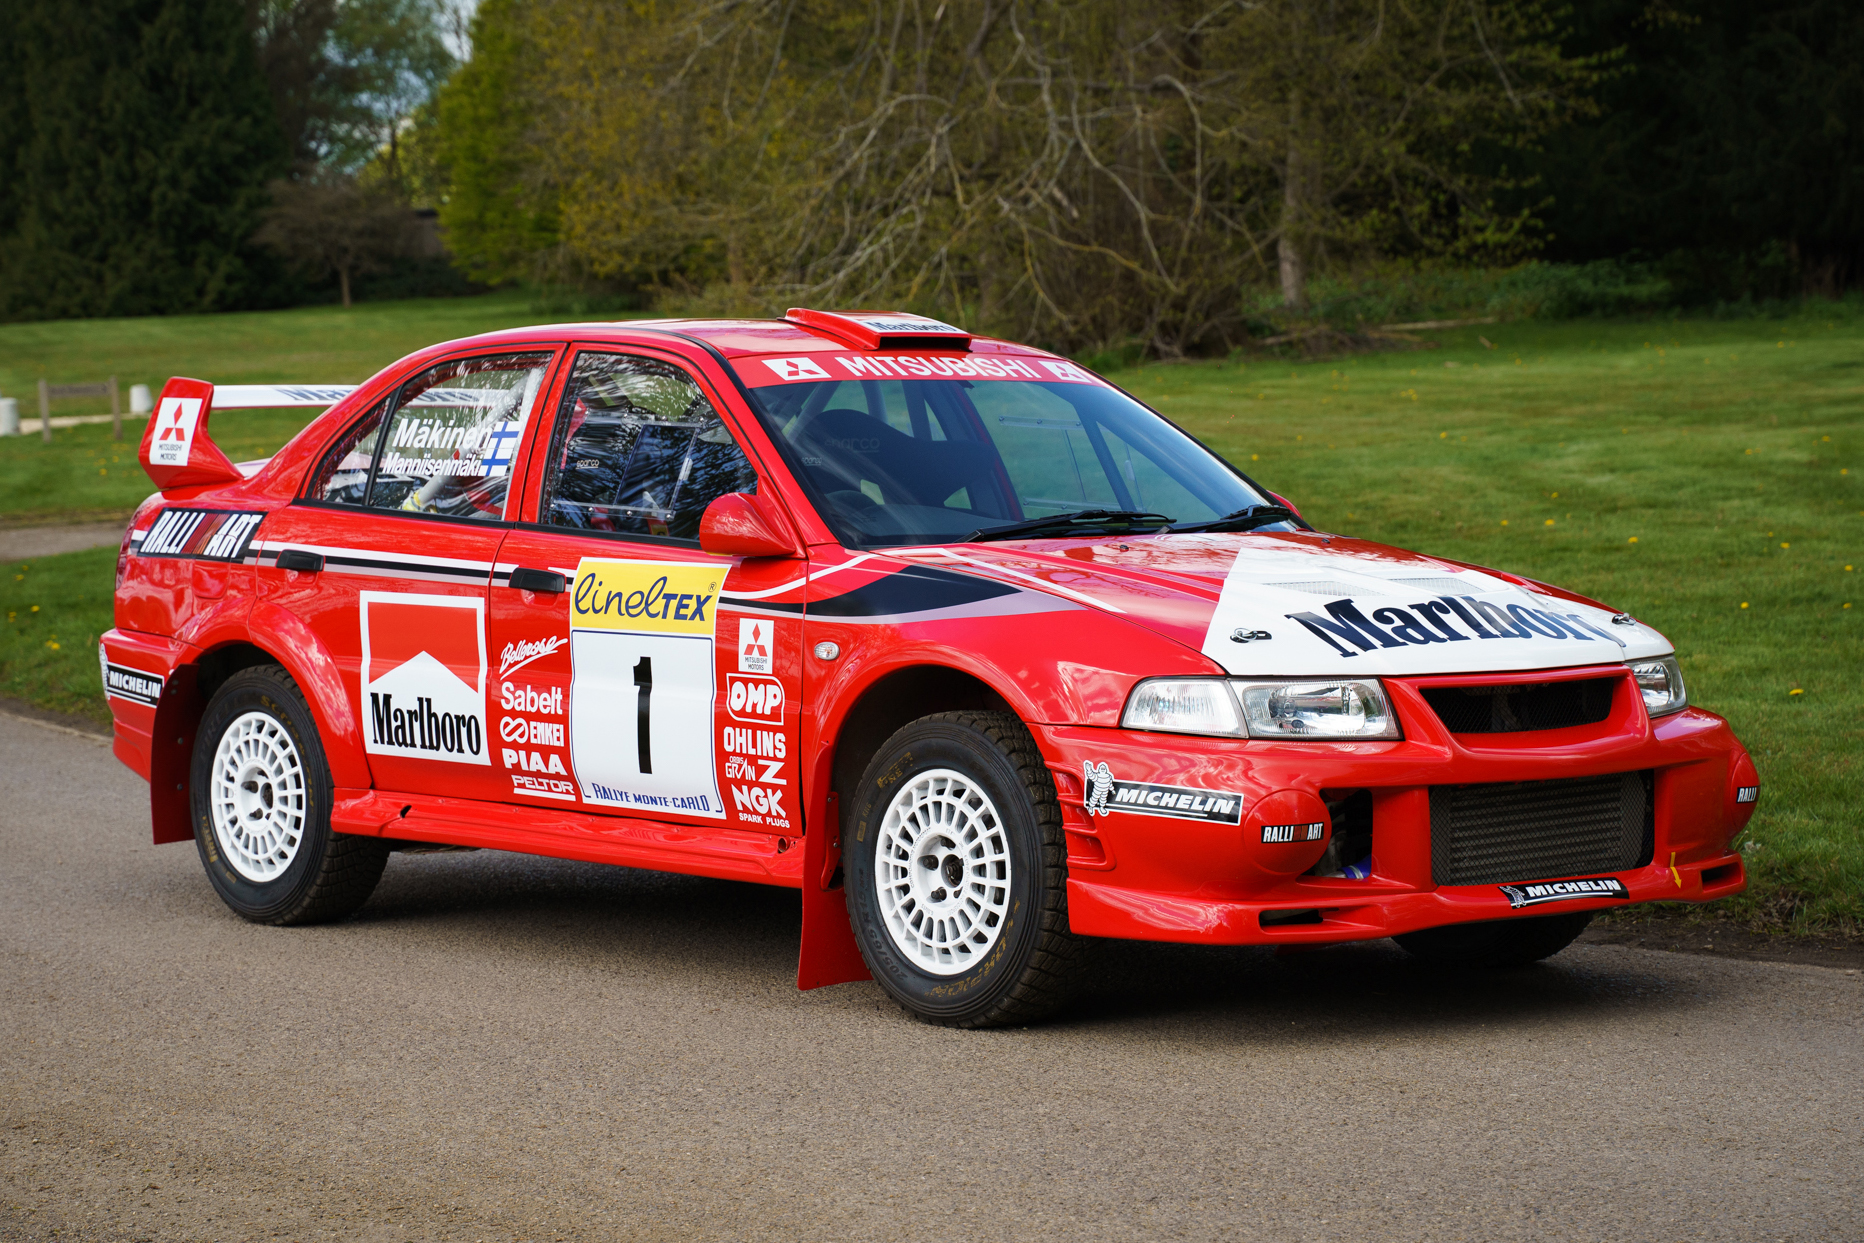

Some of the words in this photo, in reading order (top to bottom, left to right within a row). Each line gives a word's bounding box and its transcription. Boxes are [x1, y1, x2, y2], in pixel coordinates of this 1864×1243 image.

[834, 355, 1042, 378] MITSUBISHI
[392, 418, 493, 449] Mäkinen
[158, 443, 182, 452] MITSUBISHI
[160, 453, 177, 461] MOTORS
[140, 510, 206, 554] RALLI
[203, 513, 263, 558] ART
[744, 656, 768, 665] MITSUBISHI
[747, 663, 765, 671] MOTORS
[109, 671, 161, 699] MICHELIN
[500, 681, 563, 715] Sabelt
[730, 681, 782, 715] OMP
[370, 691, 482, 756] Marlboro
[633, 656, 653, 775] 1
[529, 721, 565, 747] ENKEI
[723, 726, 786, 759] OHLINS
[501, 747, 568, 776] PIAA
[757, 759, 787, 786] Z
[511, 774, 576, 794] PELTOR
[591, 782, 632, 803] RALLYE
[633, 793, 711, 812] MONTE-CARLO
[1738, 786, 1757, 803] RALLI
[731, 783, 787, 819] NGK
[1115, 787, 1237, 815] MICHELIN
[738, 812, 763, 824] SPARK
[765, 816, 791, 829] PLUGS
[1263, 826, 1294, 843] RALLI
[1306, 823, 1324, 841] ART
[1525, 878, 1622, 898] MICHELIN
